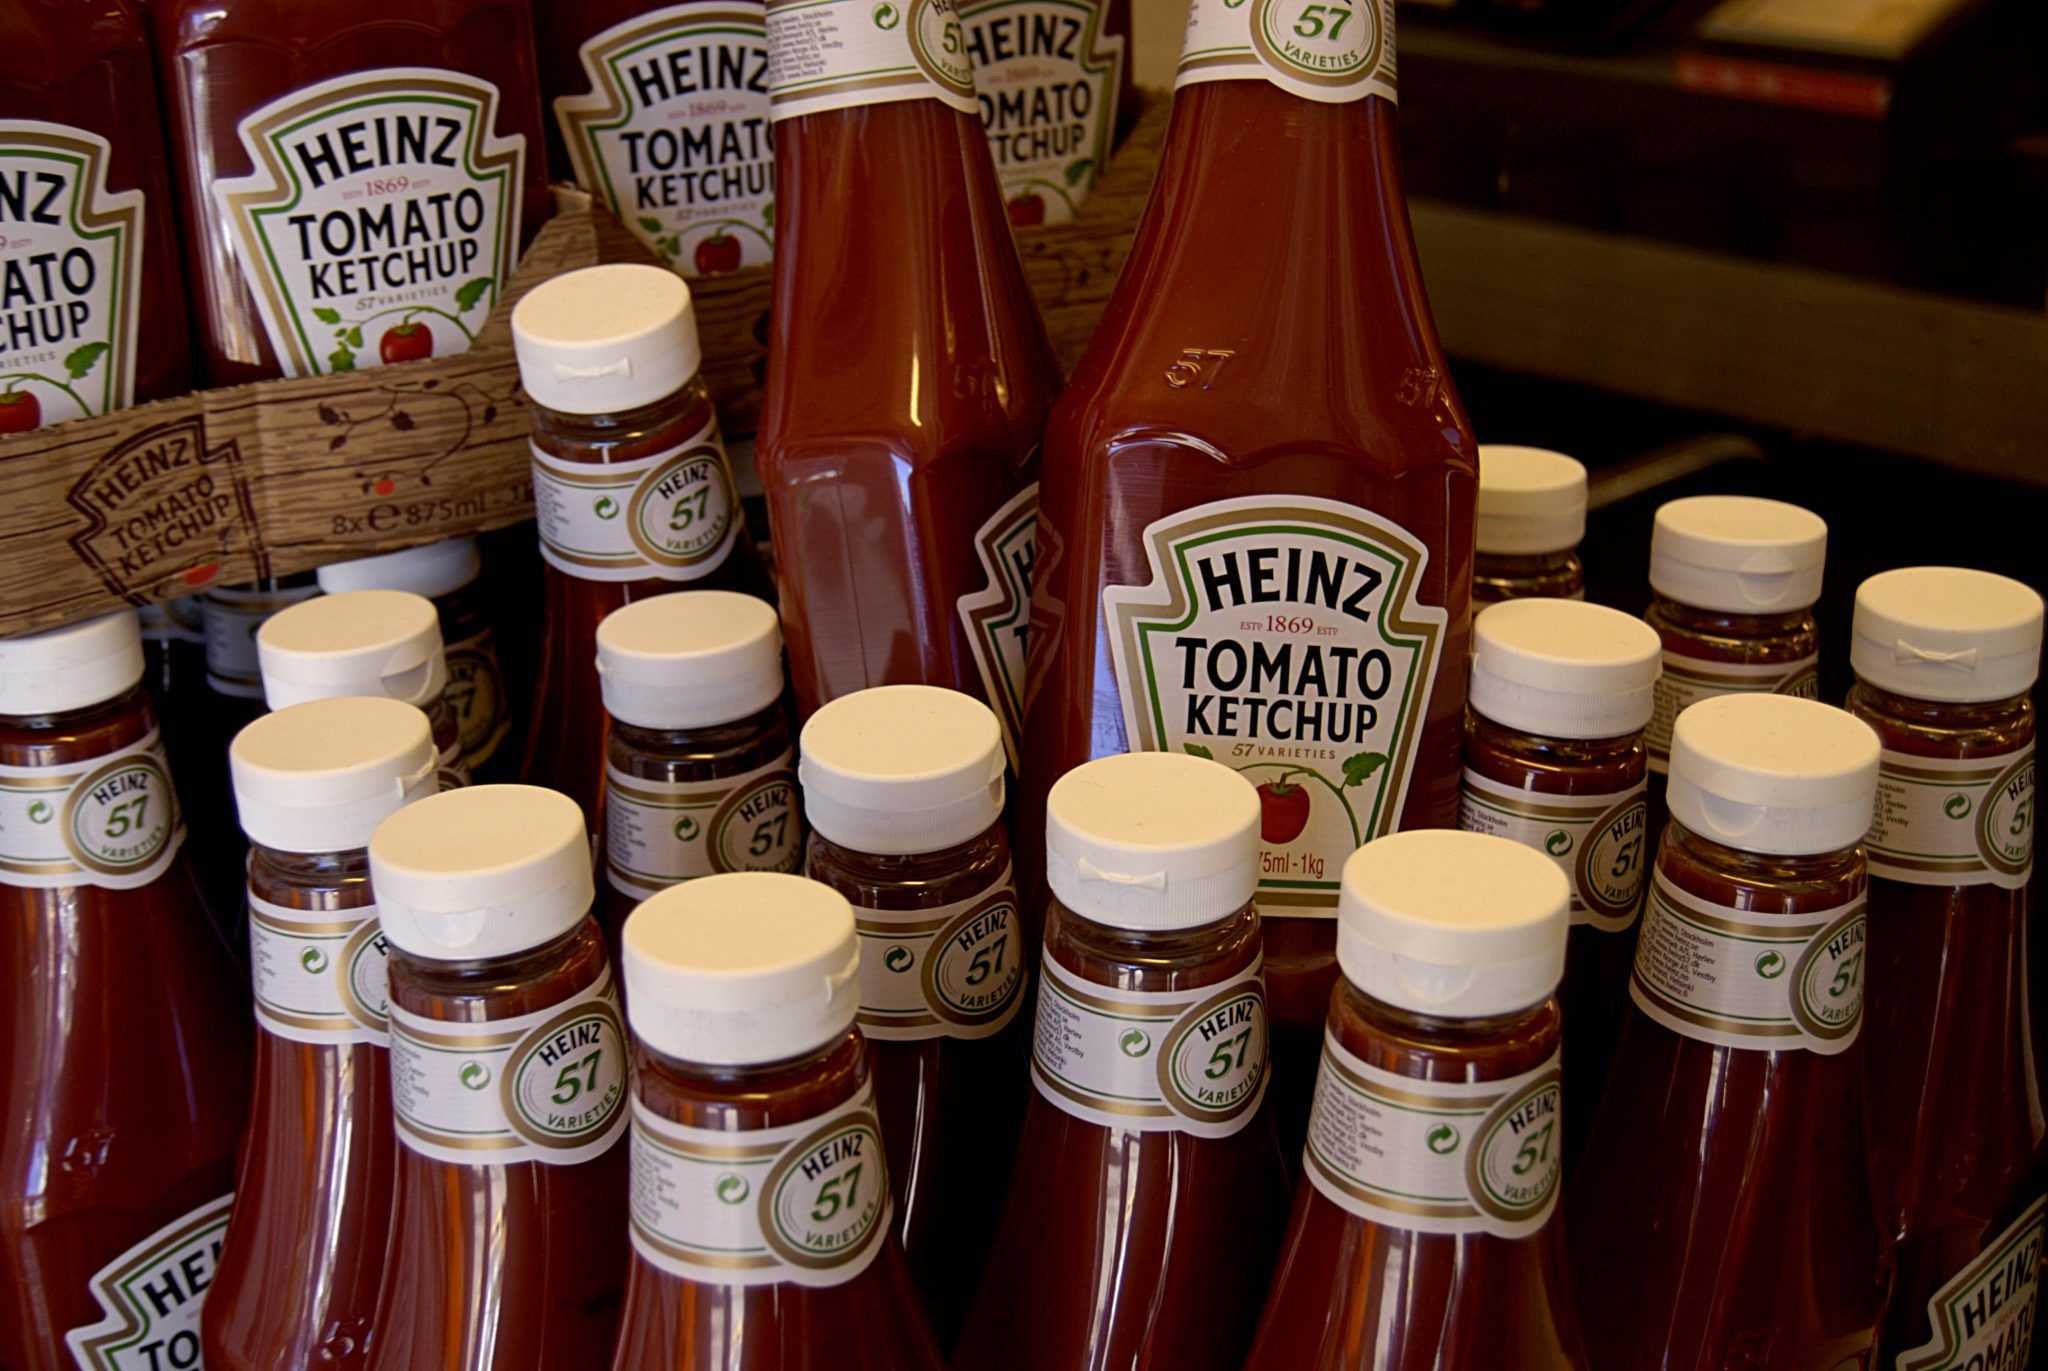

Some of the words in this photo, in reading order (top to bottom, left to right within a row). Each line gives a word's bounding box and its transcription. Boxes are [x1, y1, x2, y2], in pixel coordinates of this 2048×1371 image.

[1293, 4, 1352, 41] 57
[628, 46, 768, 107] HEINZ
[1284, 40, 1359, 68] VARIETIES
[978, 80, 1092, 129] OMATO
[294, 115, 462, 188] HEINZ
[988, 123, 1085, 164] TCHUP
[365, 176, 409, 196] 1869
[636, 162, 774, 209] KETCHU
[288, 188, 484, 260] TOMATO
[0, 247, 95, 309] ATO
[309, 238, 478, 299] KETCHUP
[355, 297, 376, 311] 57
[379, 285, 448, 305] VARIETIES
[1164, 348, 1236, 390] 57
[94, 437, 190, 511] HEINZ
[657, 463, 709, 500] HEINZ
[110, 475, 214, 549] TOMATO
[406, 491, 486, 525] 875ml
[669, 484, 711, 532] 57
[118, 494, 229, 577] KETCHUP
[666, 513, 724, 550] VARIETIES
[1198, 548, 1382, 622] HEINZ
[1267, 614, 1314, 634] 1869
[1176, 637, 1392, 700] TOMATO
[1186, 694, 1378, 744] KETCHUP
[1231, 743, 1256, 757] 57
[1258, 747, 1337, 760] VARIETIES
[93, 773, 149, 805] HEINZ
[739, 788, 789, 823] HEINZ
[105, 794, 150, 838] 57
[748, 811, 790, 857] 57
[1259, 852, 1290, 873] 5ml
[1301, 852, 1324, 879] 1kg
[1611, 834, 1643, 878] 57
[957, 910, 1008, 952] HEINZ
[965, 934, 1008, 986] 57
[960, 965, 1017, 1007] VARIETIES
[1199, 1000, 1254, 1042] HEINZ
[539, 1022, 602, 1067] HEINZ
[1204, 1026, 1253, 1081] 57
[551, 1048, 603, 1105] 57
[1198, 1062, 1259, 1104] VARIETIES
[547, 1083, 617, 1130] VARIETIES
[800, 1135, 863, 1182] HEINZ
[1512, 1119, 1554, 1175] 57
[811, 1162, 863, 1222] 57
[805, 1201, 876, 1247] VARIETIES
[1962, 1237, 2038, 1340] HEINZ
